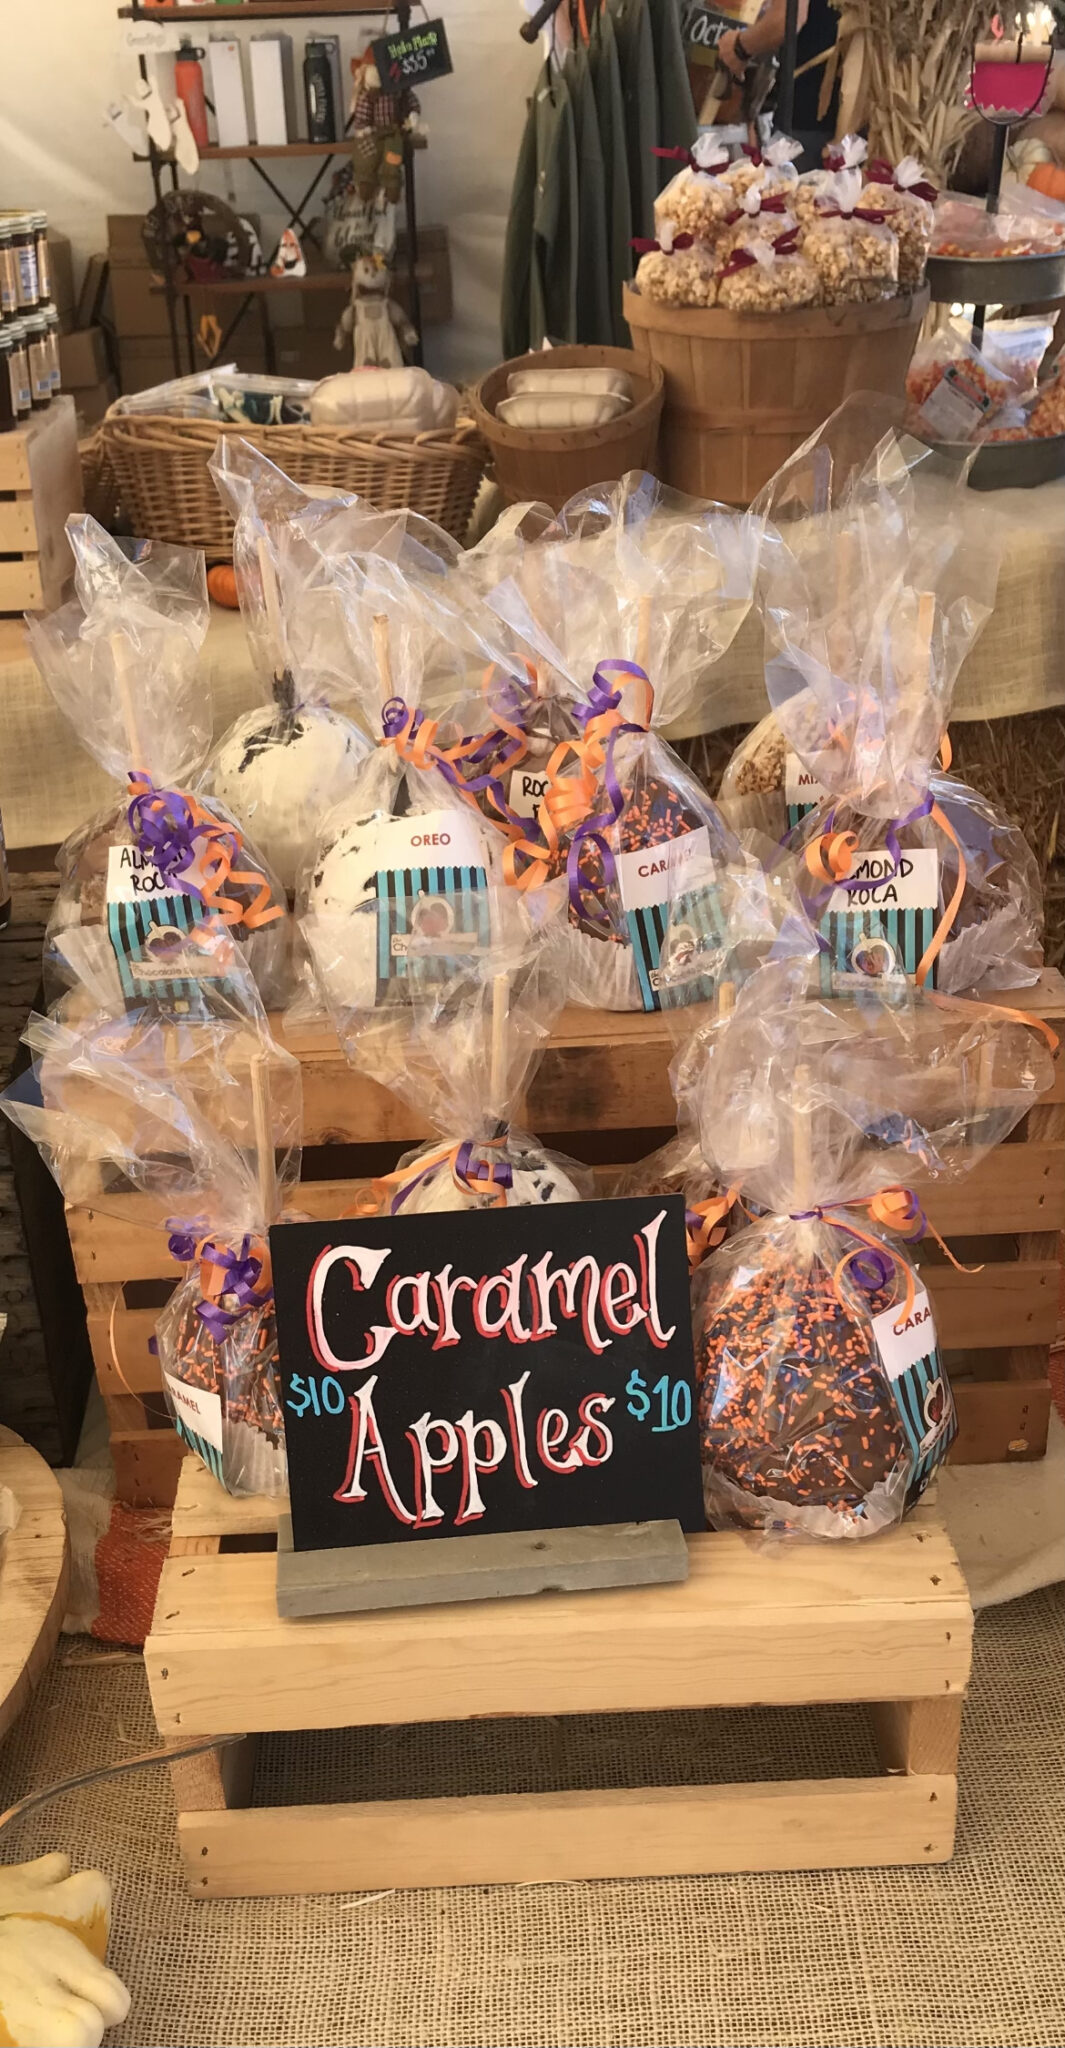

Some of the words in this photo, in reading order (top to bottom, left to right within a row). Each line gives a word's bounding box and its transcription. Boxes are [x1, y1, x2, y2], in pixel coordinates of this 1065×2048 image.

[522, 776, 549, 797] ROC
[410, 833, 451, 847] OREO
[130, 872, 178, 896] ROC
[306, 1209, 677, 1372] Caramel
[892, 1306, 932, 1337] CARA
[286, 1372, 345, 1418] $10
[625, 1368, 693, 1433] $10
[333, 1370, 616, 1530] Apples
